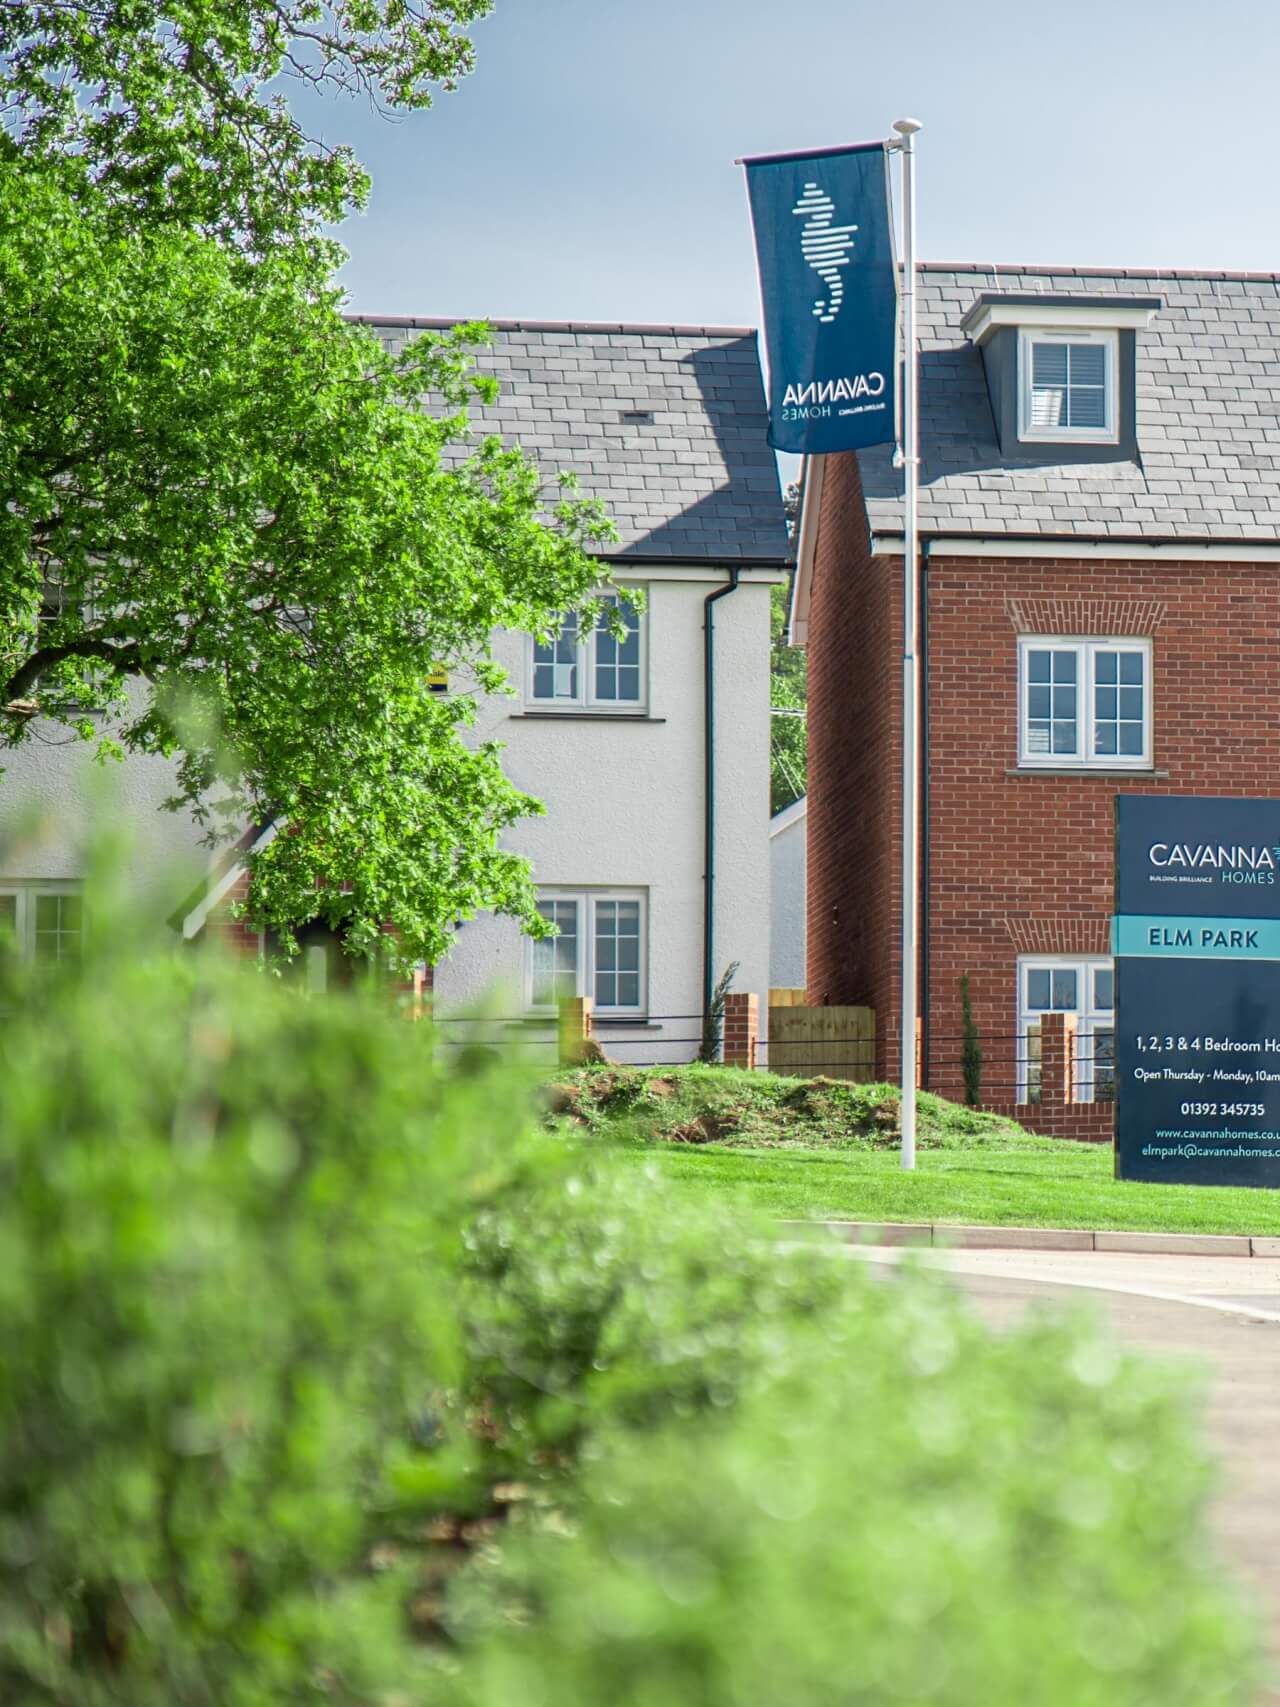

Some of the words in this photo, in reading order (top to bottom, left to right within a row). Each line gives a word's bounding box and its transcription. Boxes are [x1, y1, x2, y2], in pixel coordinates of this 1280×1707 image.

[1149, 843, 1275, 869] CAVANNA
[1222, 871, 1275, 884] HOMES
[1149, 928, 1193, 947] ELM
[1201, 929, 1259, 948] PARK
[1136, 1036, 1146, 1052] 1,
[1149, 1036, 1162, 1052] 2,
[1165, 1036, 1174, 1050] 3
[1177, 1037, 1188, 1050] &
[1190, 1037, 1201, 1050] 4
[1204, 1037, 1261, 1051] Bedroom
[1134, 1068, 1161, 1082] Open
[1163, 1068, 1205, 1083] Thursday
[1213, 1069, 1254, 1084] Monday,
[1255, 1070, 1280, 1081] 10am
[1180, 1103, 1217, 1115] 01392
[1219, 1103, 1265, 1116] 345735
